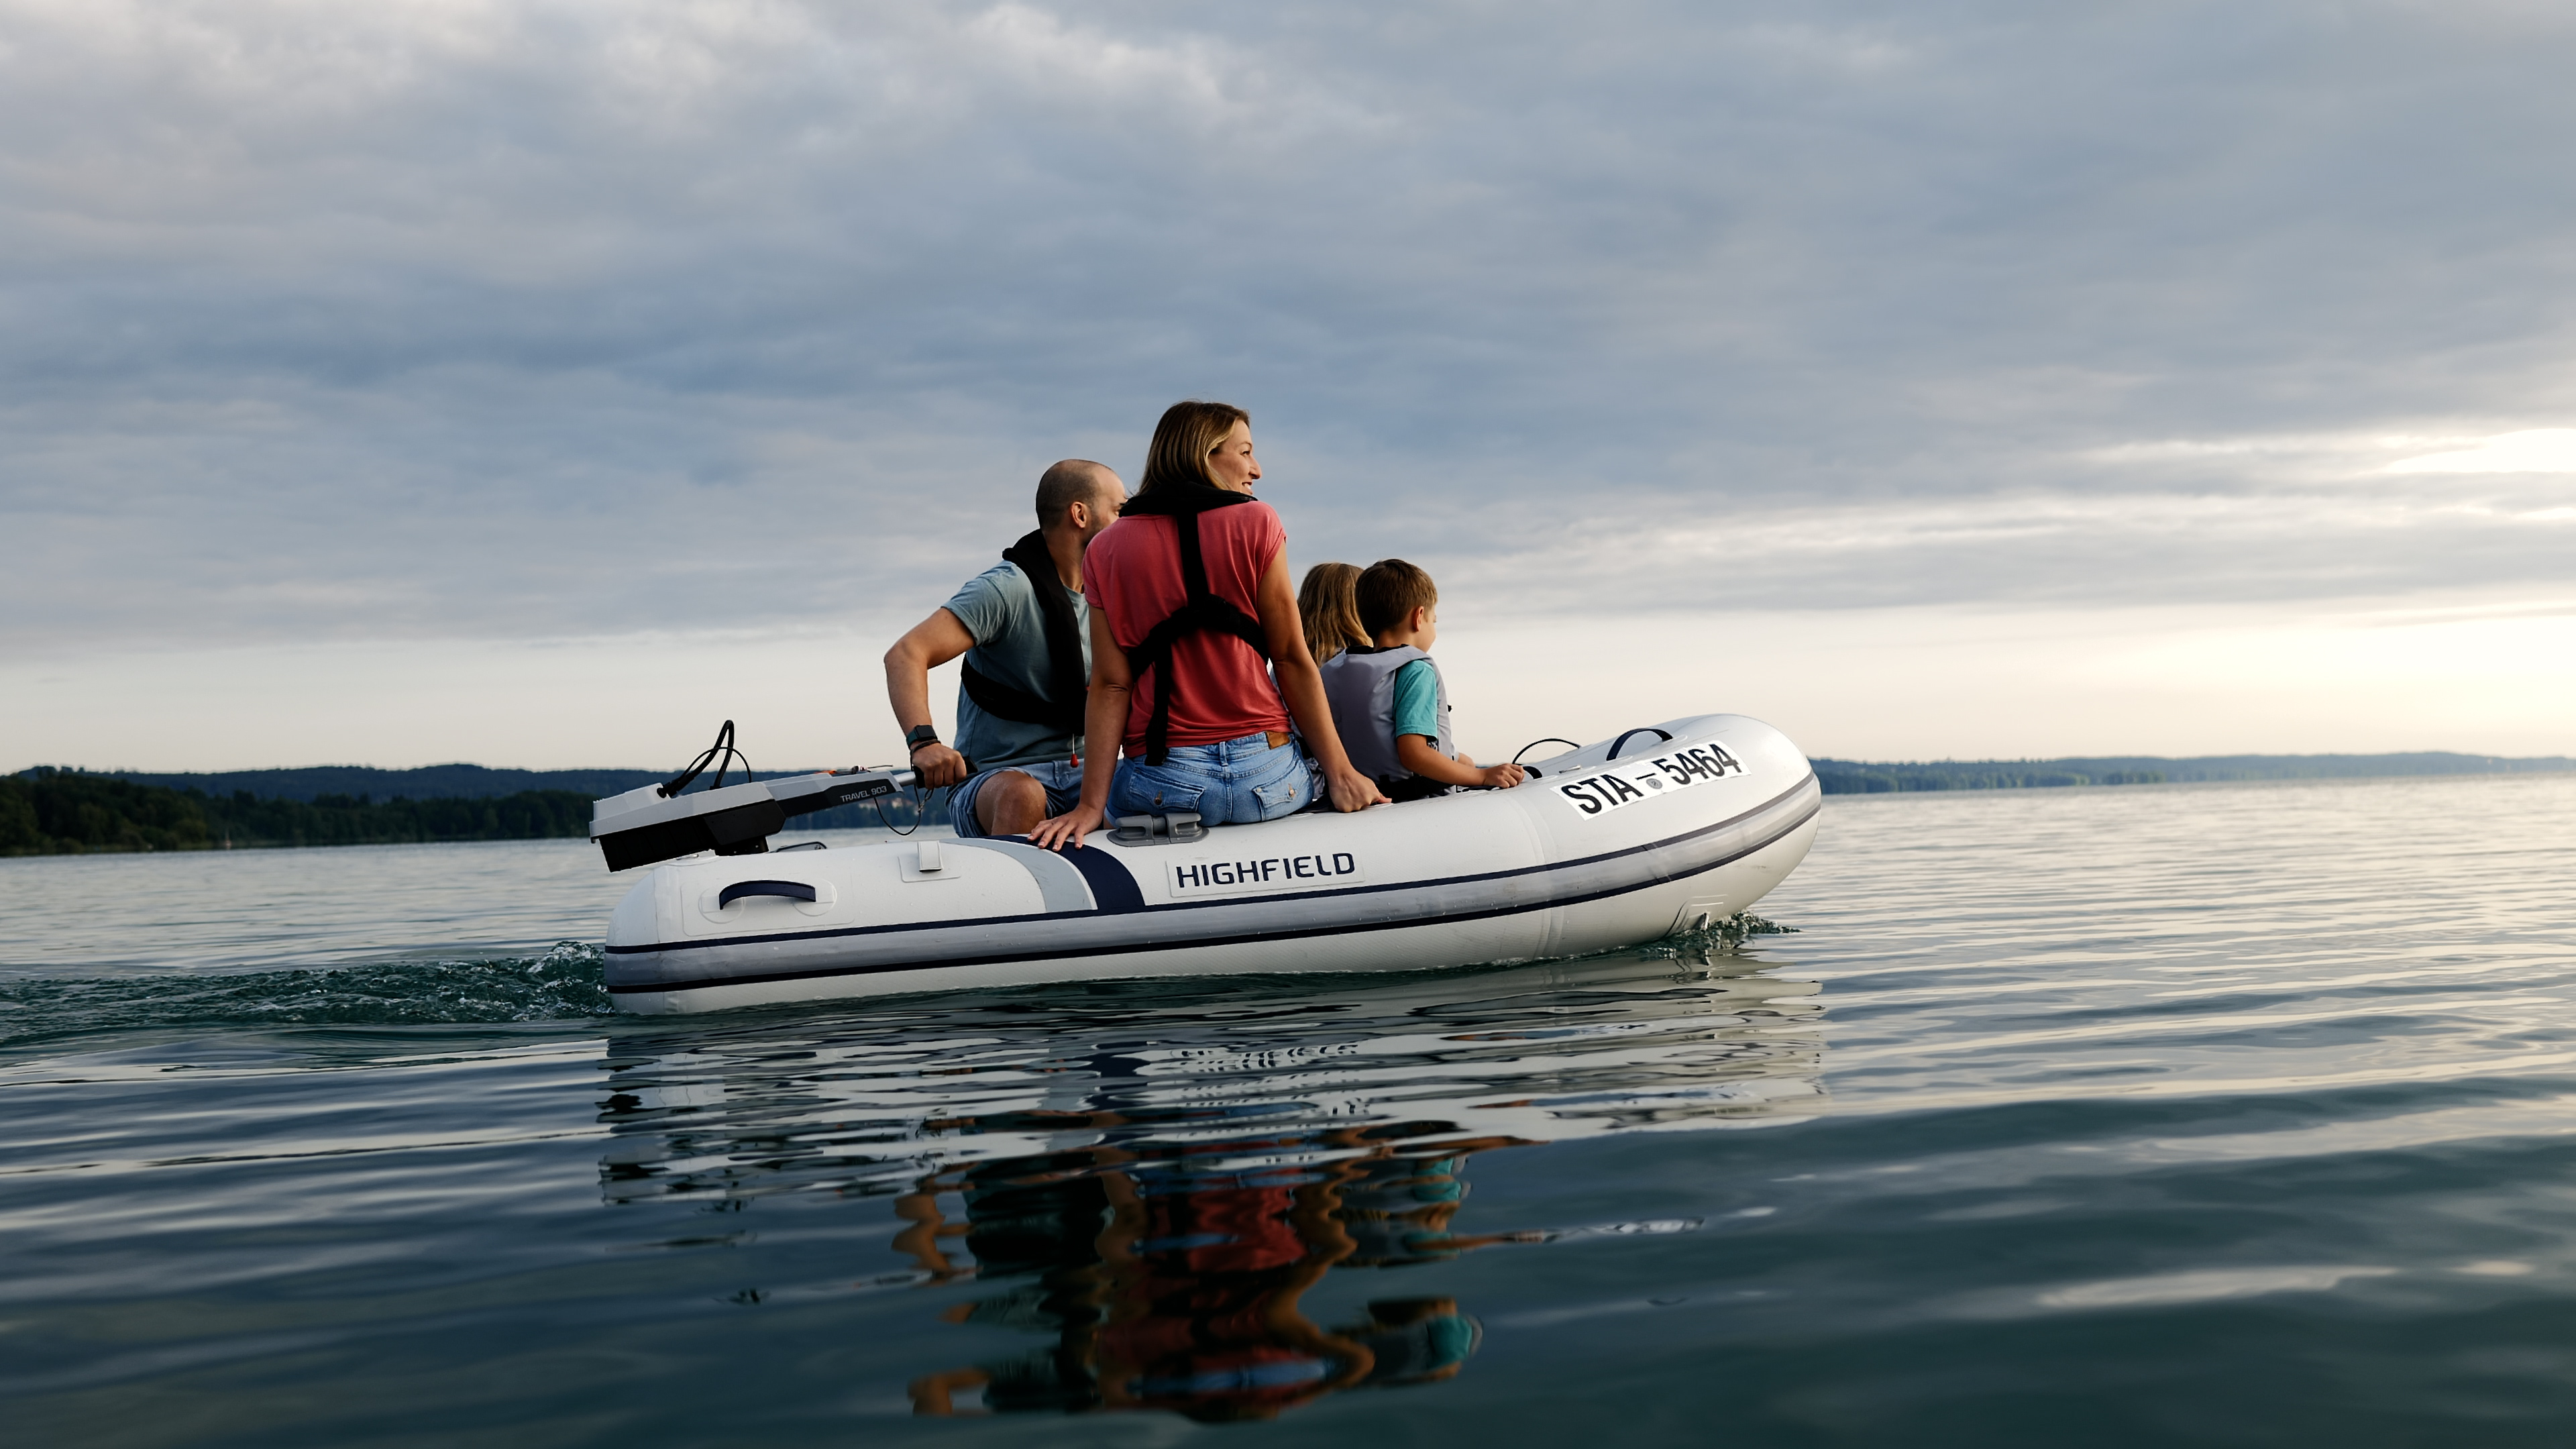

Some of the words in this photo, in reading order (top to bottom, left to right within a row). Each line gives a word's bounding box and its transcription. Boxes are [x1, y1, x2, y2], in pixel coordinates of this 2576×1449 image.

[840, 790, 871, 802] TRAVEL
[871, 786, 887, 796] 903
[1560, 773, 1644, 814] STA
[1651, 743, 1742, 786] 5464
[1176, 852, 1355, 888] HIGHFIELD
